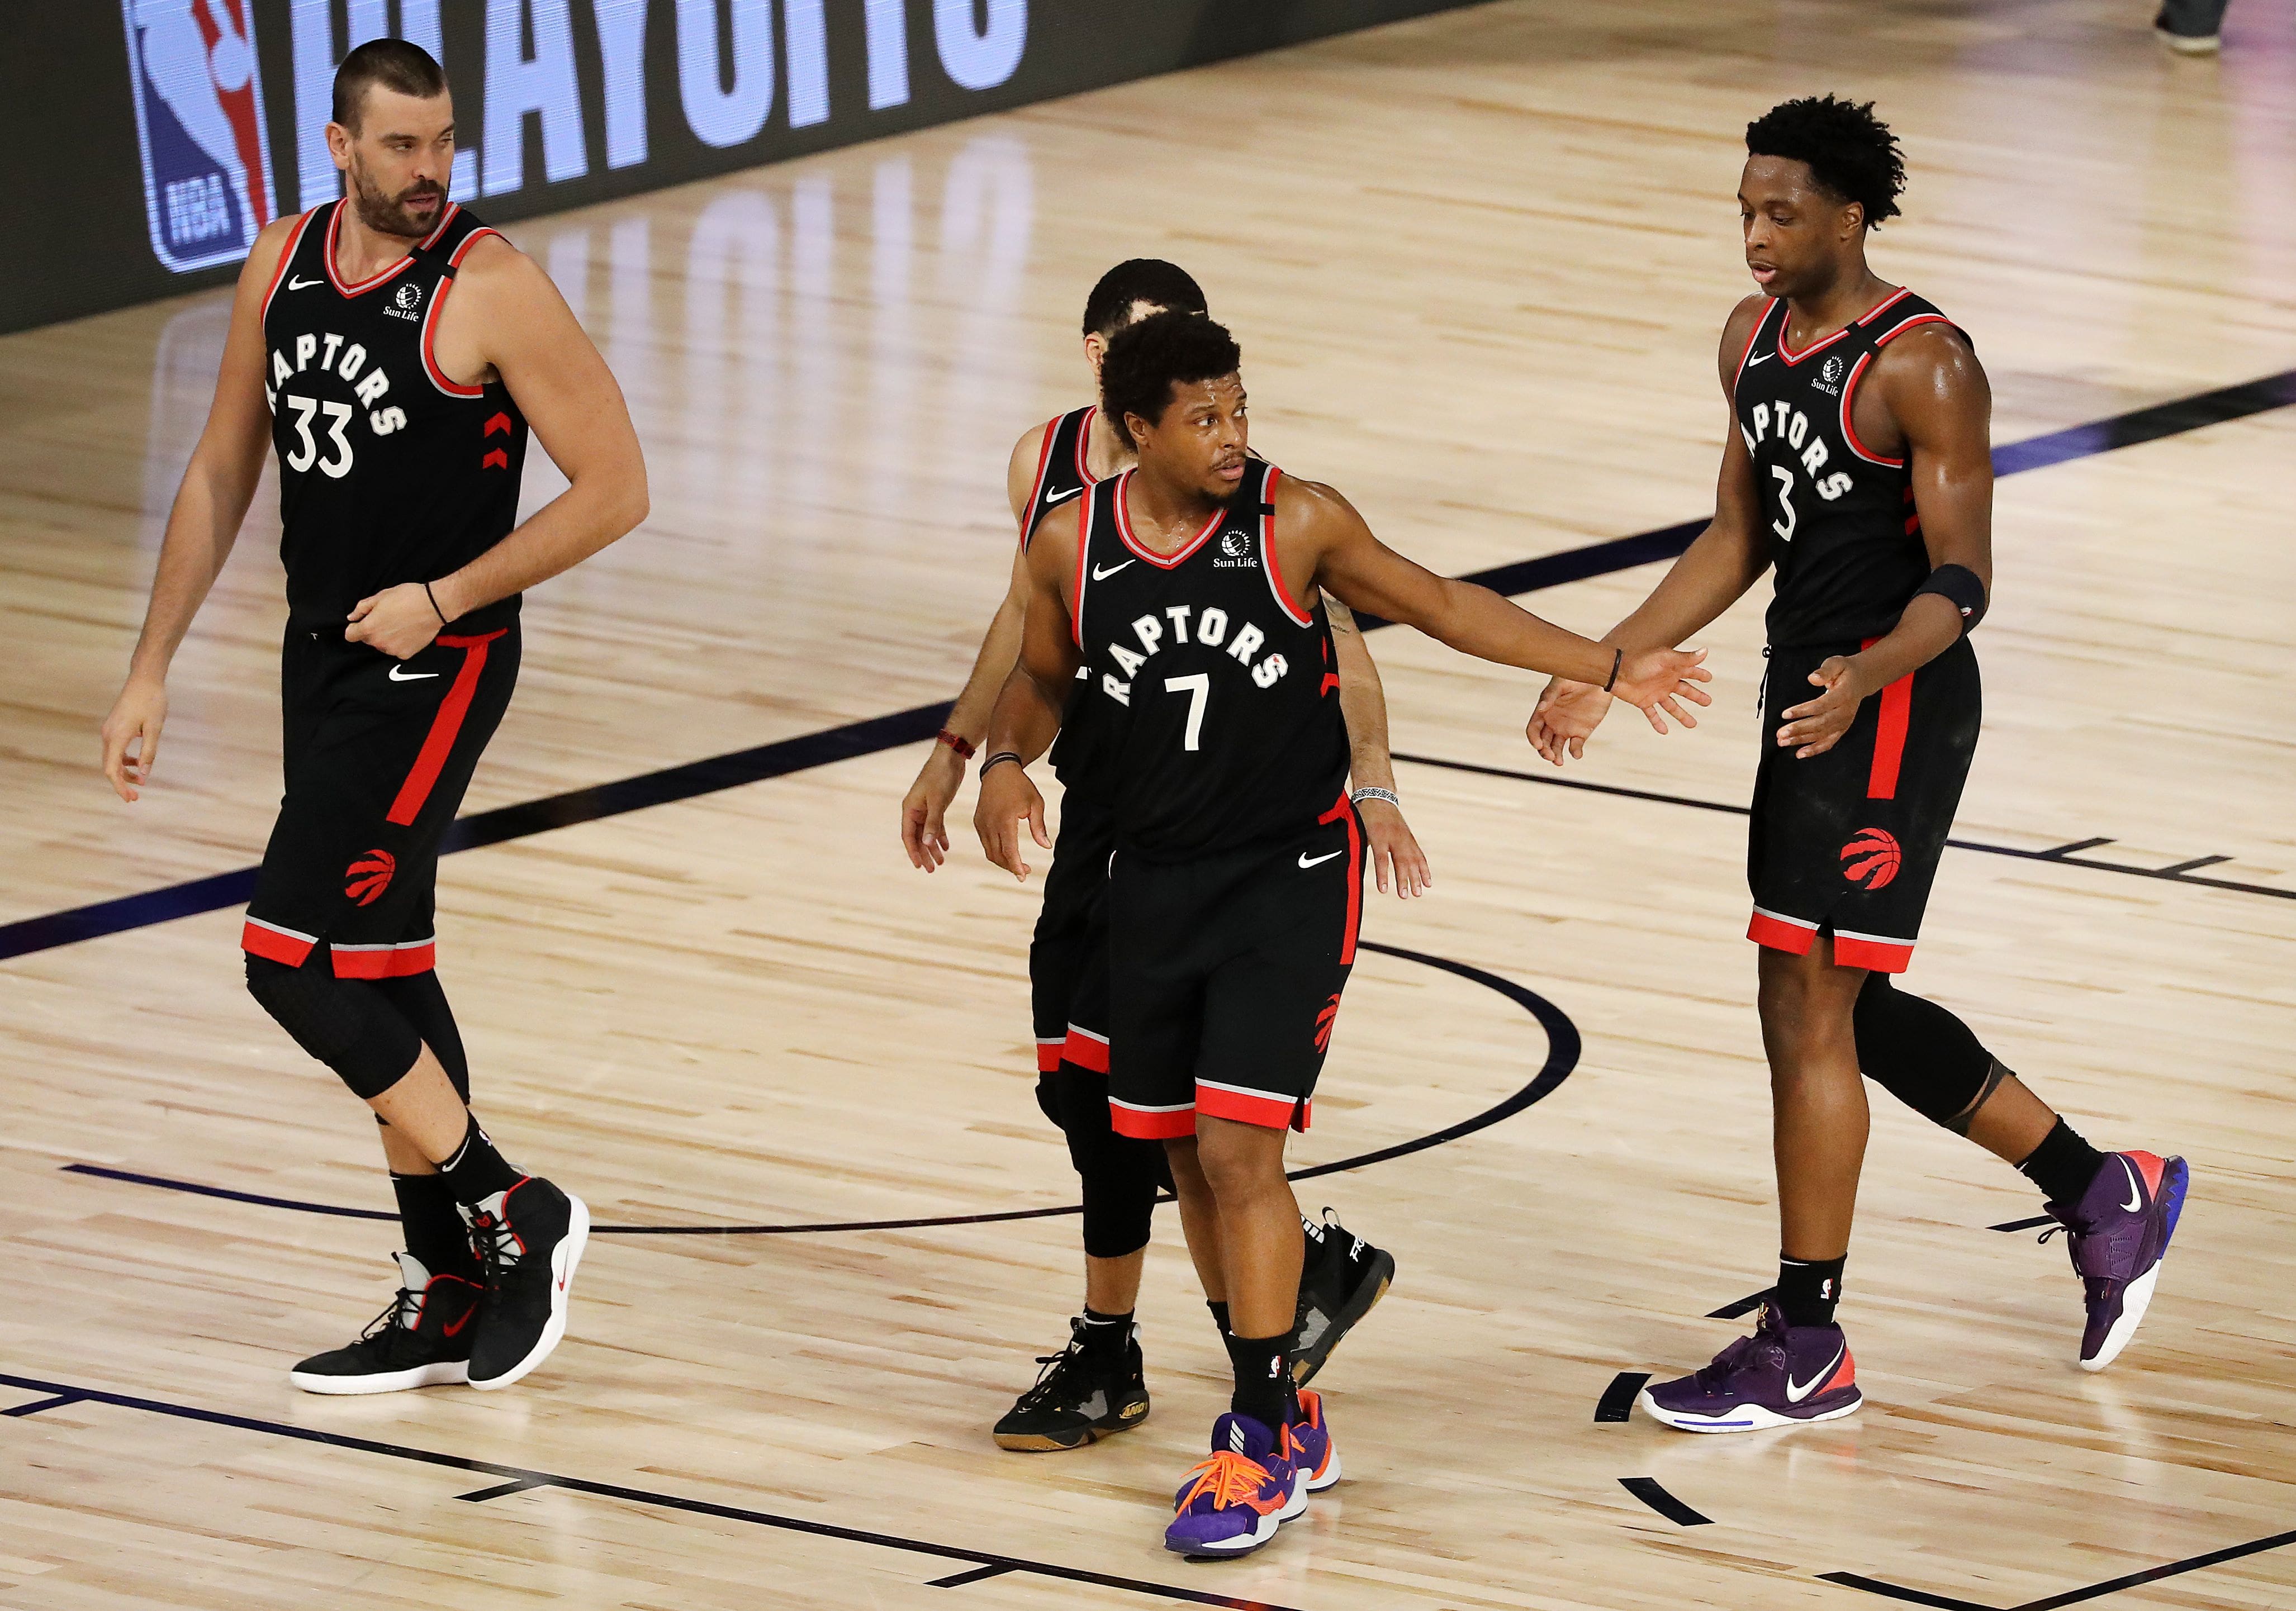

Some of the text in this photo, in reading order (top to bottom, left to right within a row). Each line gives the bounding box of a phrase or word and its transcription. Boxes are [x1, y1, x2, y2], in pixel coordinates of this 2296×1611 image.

[383, 306, 419, 322] Sun Life
[1811, 378, 1838, 397] Sun Life
[287, 395, 354, 478] 33
[1740, 400, 1854, 501] APTORS
[1771, 464, 1796, 542] 3
[1213, 557, 1258, 568] Sun Life
[1102, 605, 1289, 707] RAPTORS
[1164, 673, 1209, 751] 7
